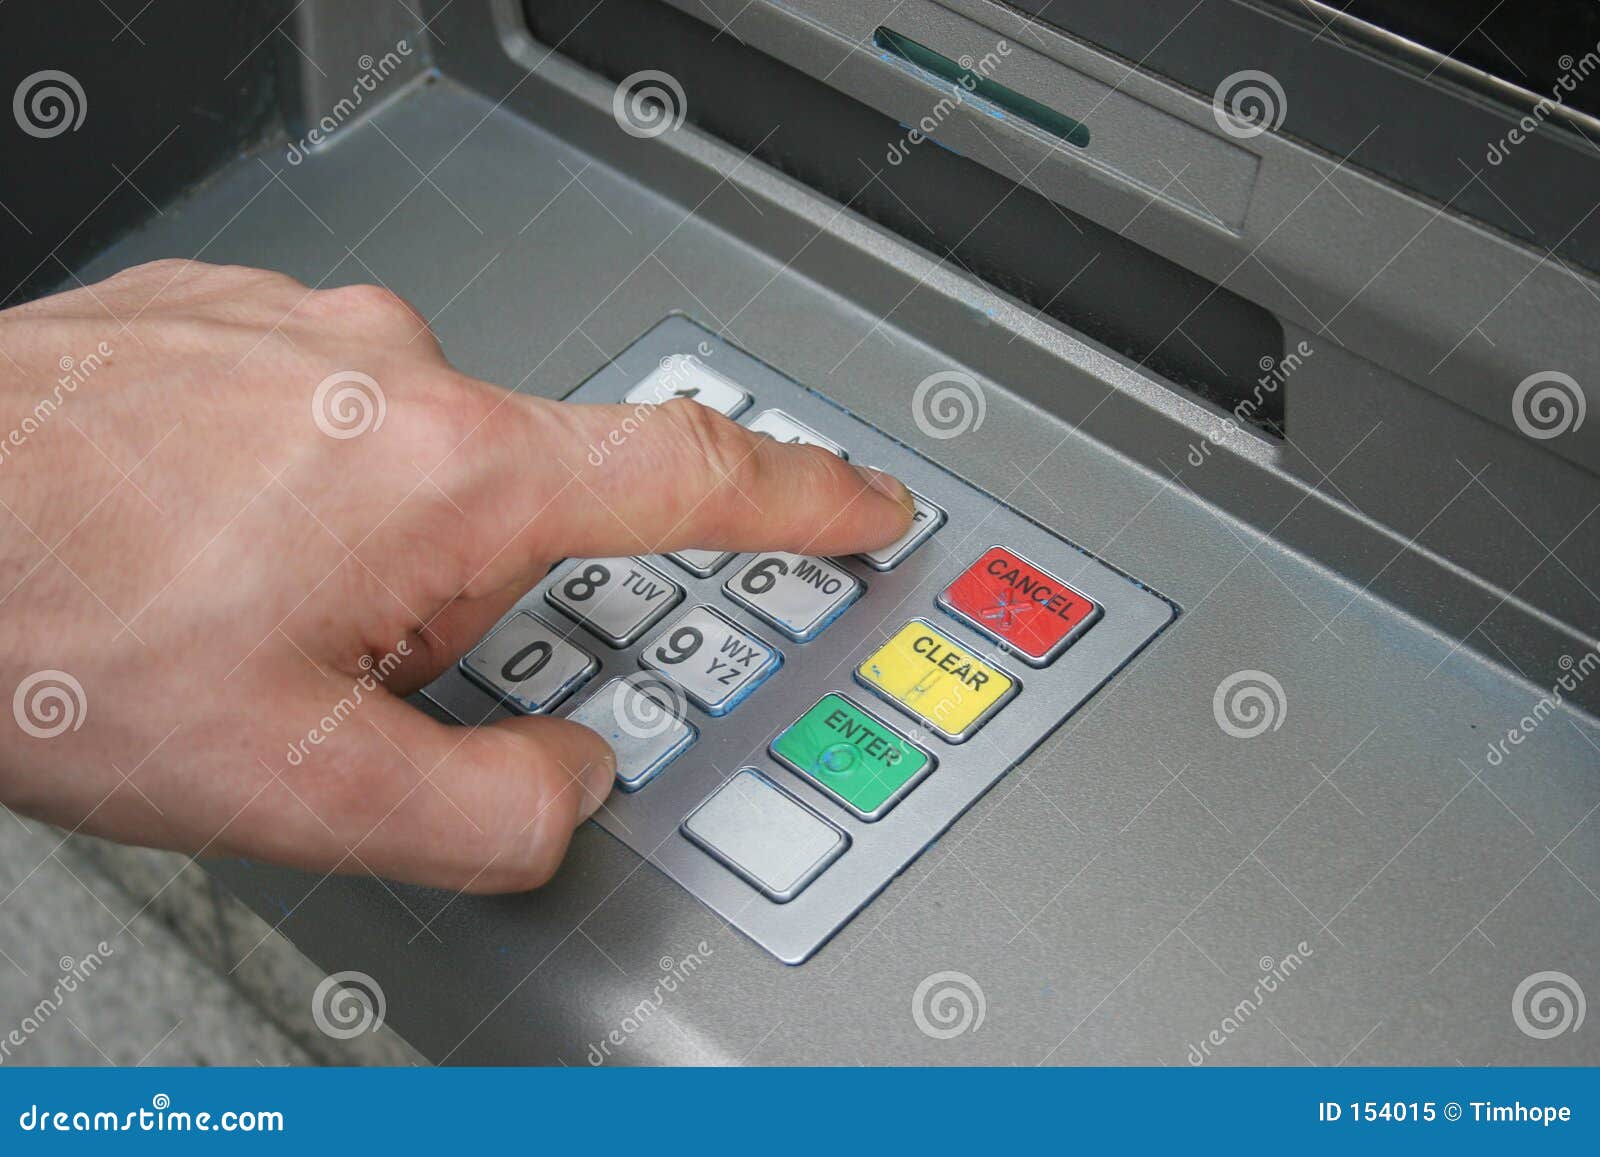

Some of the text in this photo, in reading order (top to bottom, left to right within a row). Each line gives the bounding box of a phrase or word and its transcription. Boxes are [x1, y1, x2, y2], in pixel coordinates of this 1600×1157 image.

[564, 564, 665, 601] 8 TUV
[741, 558, 841, 594] 6 MNO
[987, 559, 1072, 621] CANCEL
[501, 640, 552, 682] 0
[656, 626, 760, 667] 9 WX
[912, 636, 989, 692] CLEAR
[706, 657, 740, 685] YZ
[823, 709, 902, 767] ENTER
